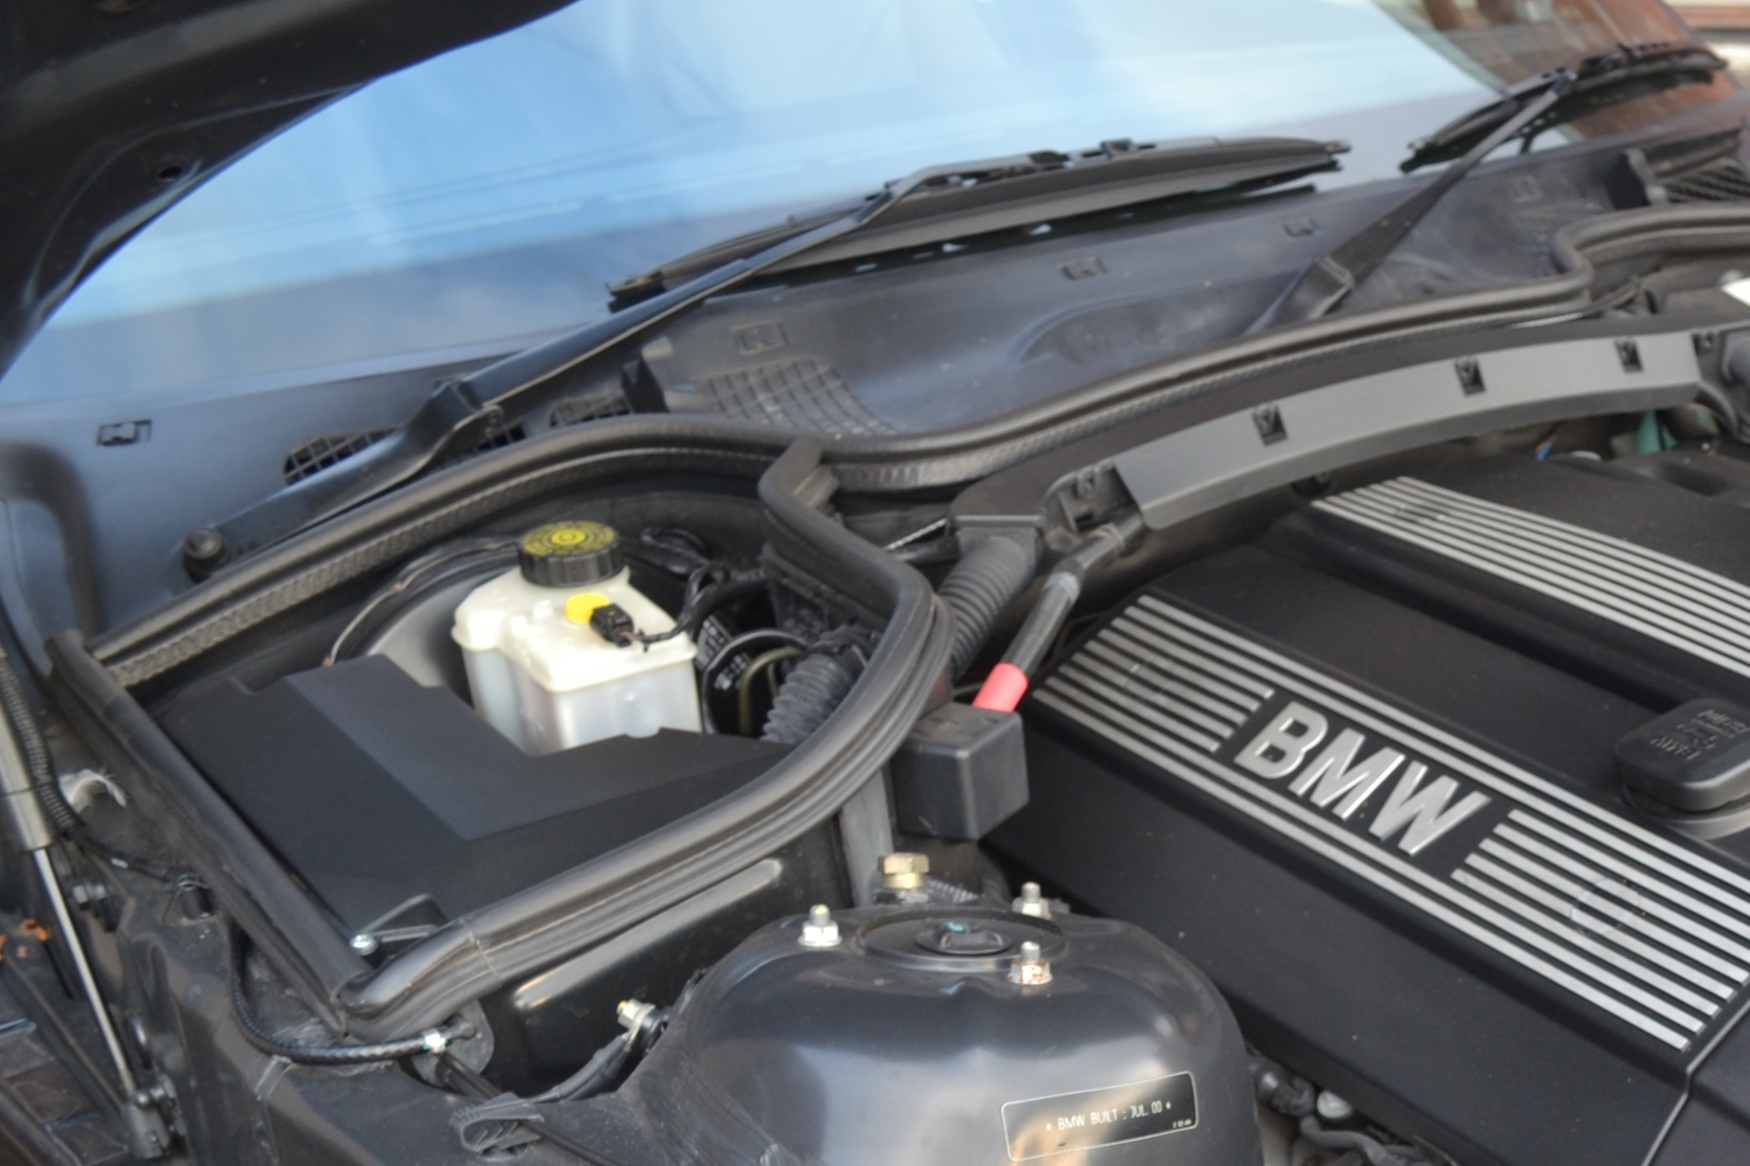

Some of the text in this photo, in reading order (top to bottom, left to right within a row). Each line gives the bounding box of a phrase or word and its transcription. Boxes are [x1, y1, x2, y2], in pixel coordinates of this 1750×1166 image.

[1234, 701, 1492, 856] BMW
[1057, 1113, 1085, 1130] BMW
[1090, 1108, 1118, 1125] BUILT
